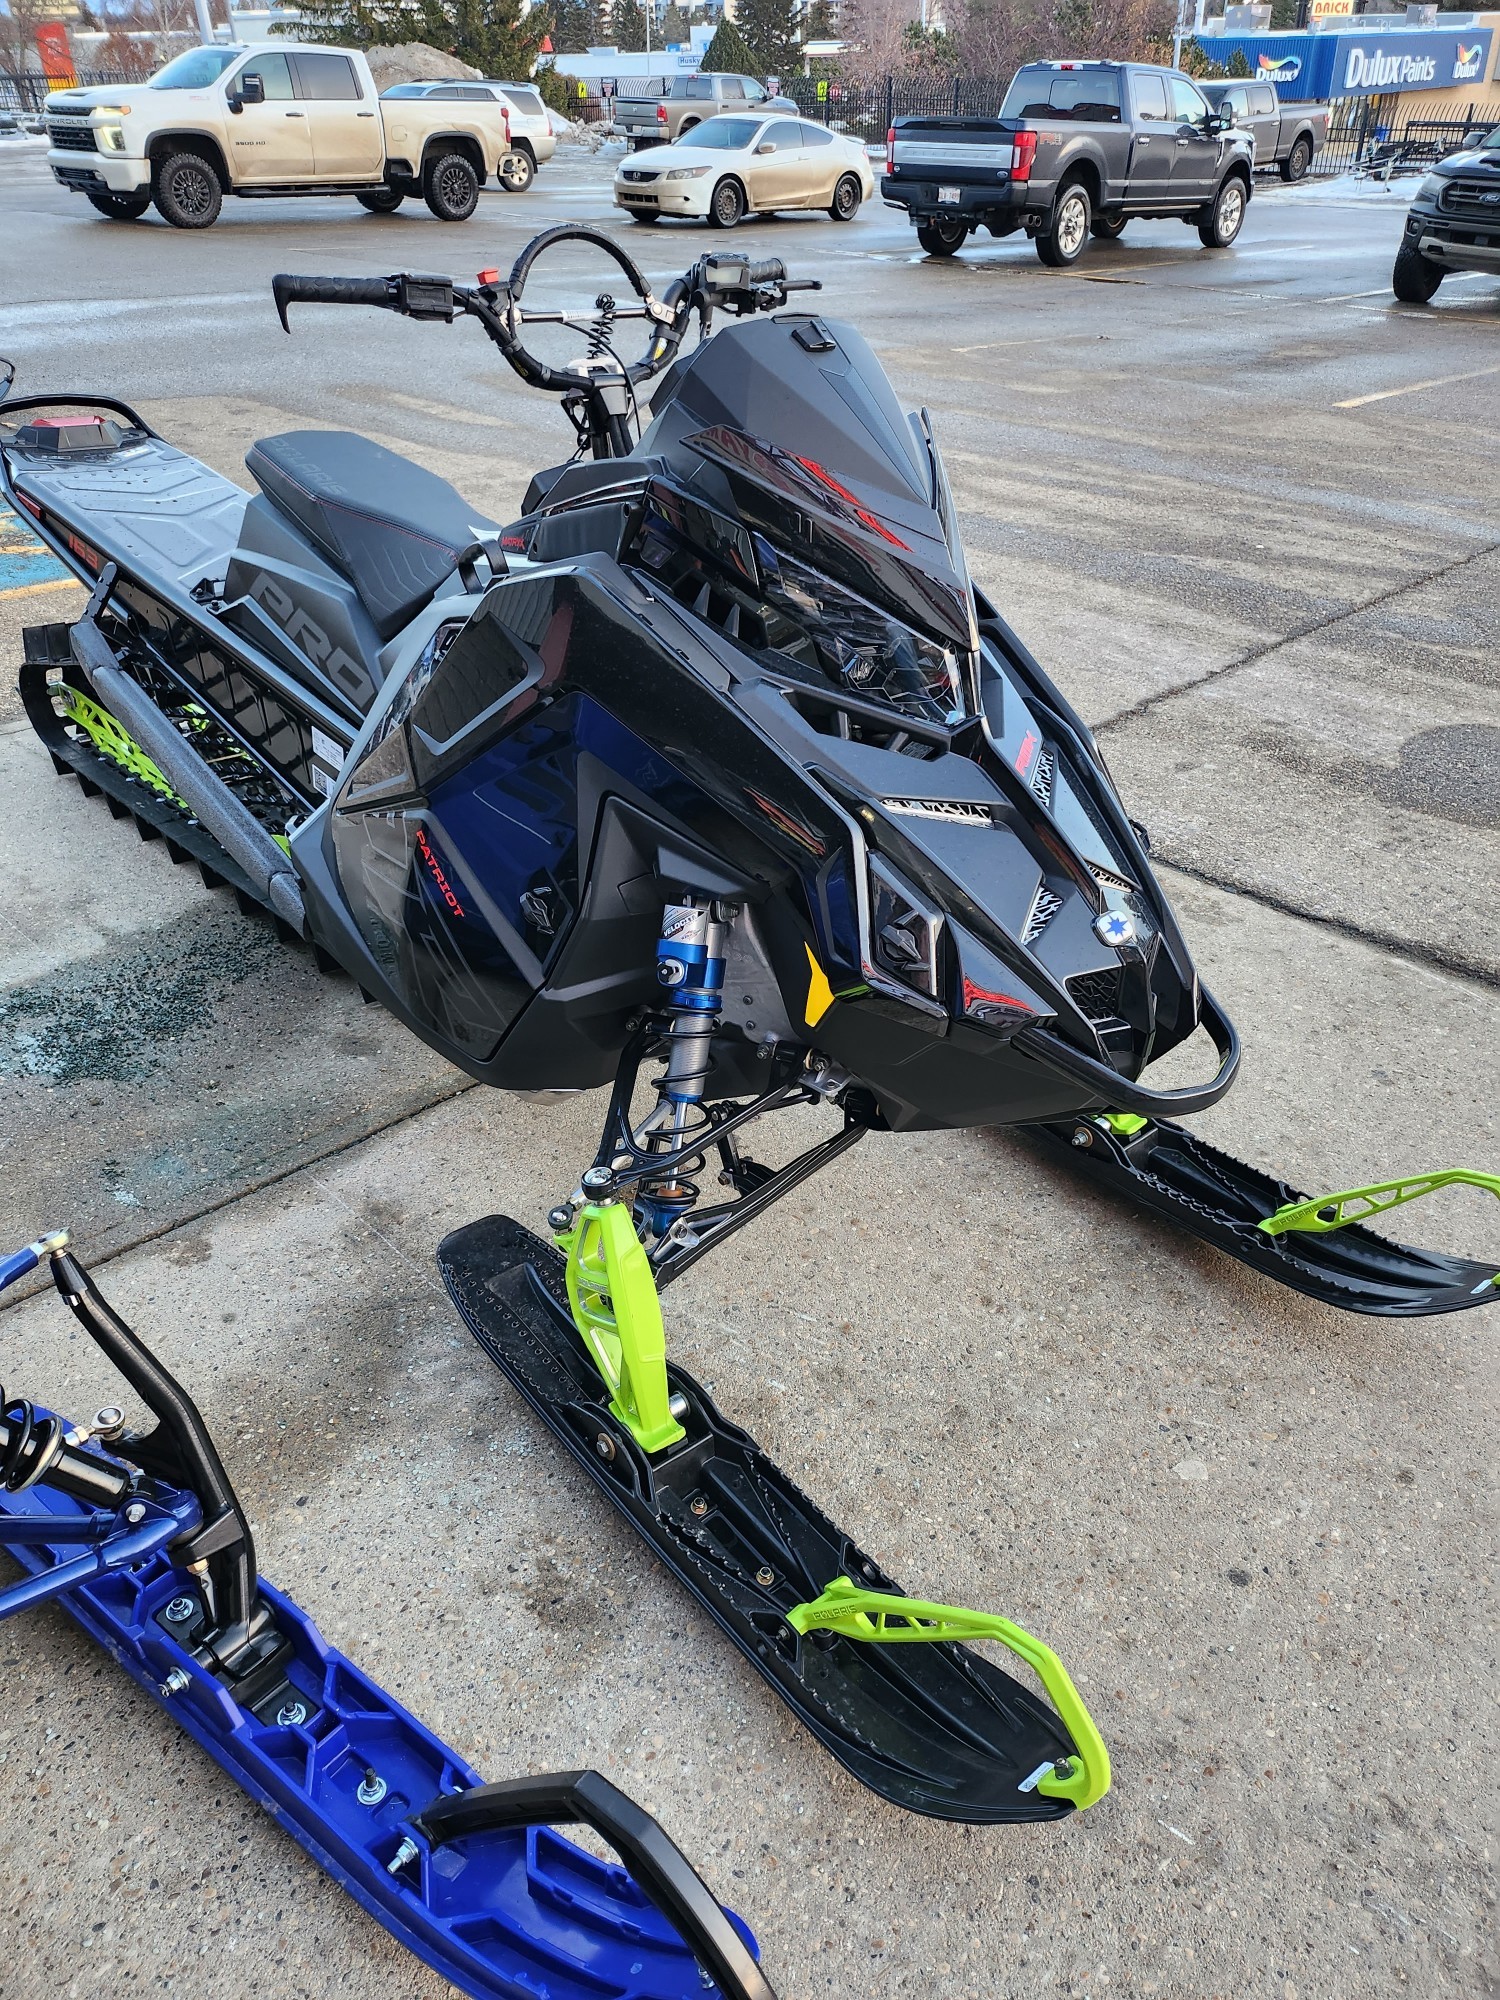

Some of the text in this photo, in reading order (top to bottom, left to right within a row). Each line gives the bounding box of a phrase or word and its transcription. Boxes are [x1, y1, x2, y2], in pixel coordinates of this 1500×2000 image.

[1314, 2, 1350, 14] BRICK
[680, 57, 701, 66] Husky
[1344, 48, 1436, 89] Dulux Paints
[1451, 60, 1478, 79] Dulux
[1255, 67, 1295, 82] Dulux
[250, 571, 375, 709] PRO
[415, 829, 465, 918] PATRIOT
[1278, 1205, 1320, 1226] POLARIS
[812, 1604, 857, 1620] POLARIS
